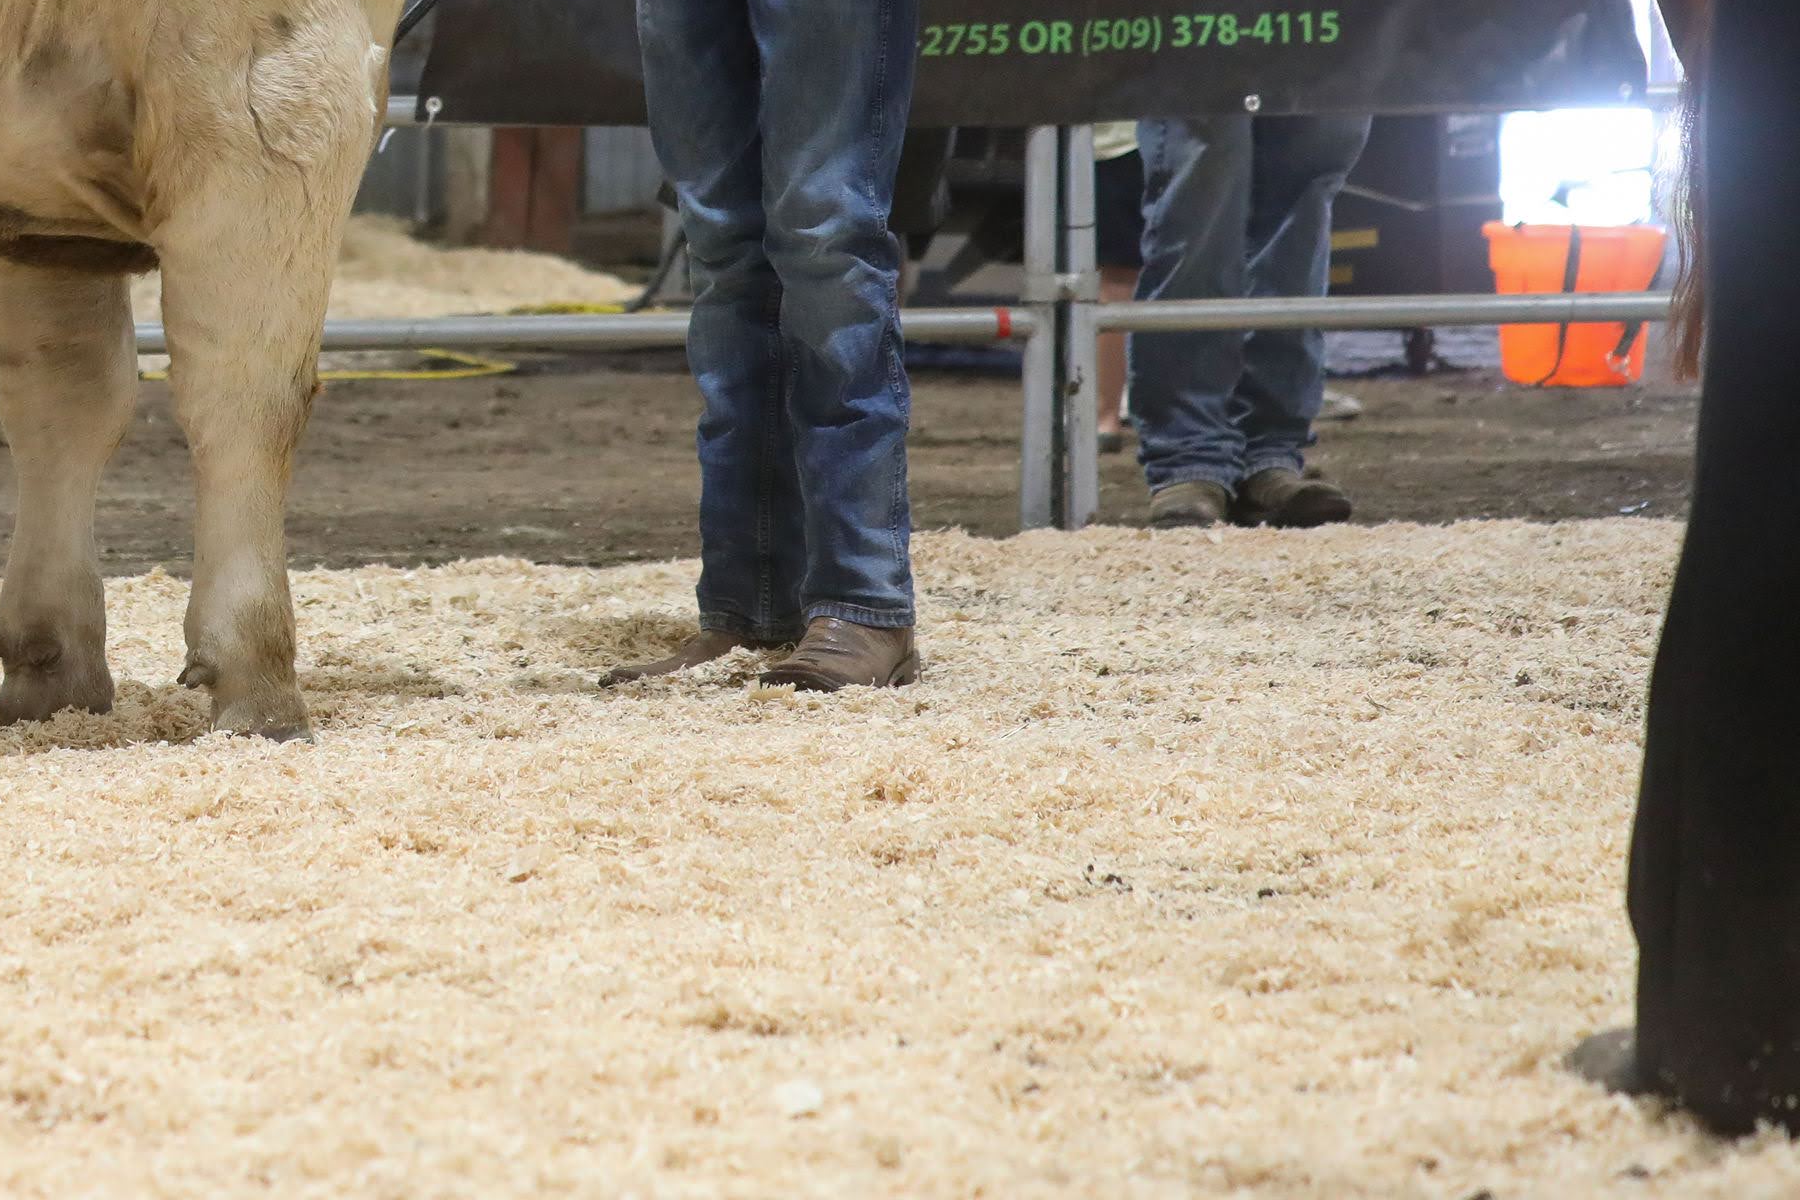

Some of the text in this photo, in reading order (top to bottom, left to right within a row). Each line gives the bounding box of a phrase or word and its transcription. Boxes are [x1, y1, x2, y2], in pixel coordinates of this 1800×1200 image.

[1018, 19, 1075, 55] OR
[1080, 15, 1163, 57] (509)
[1170, 8, 1343, 49] 378-4115
